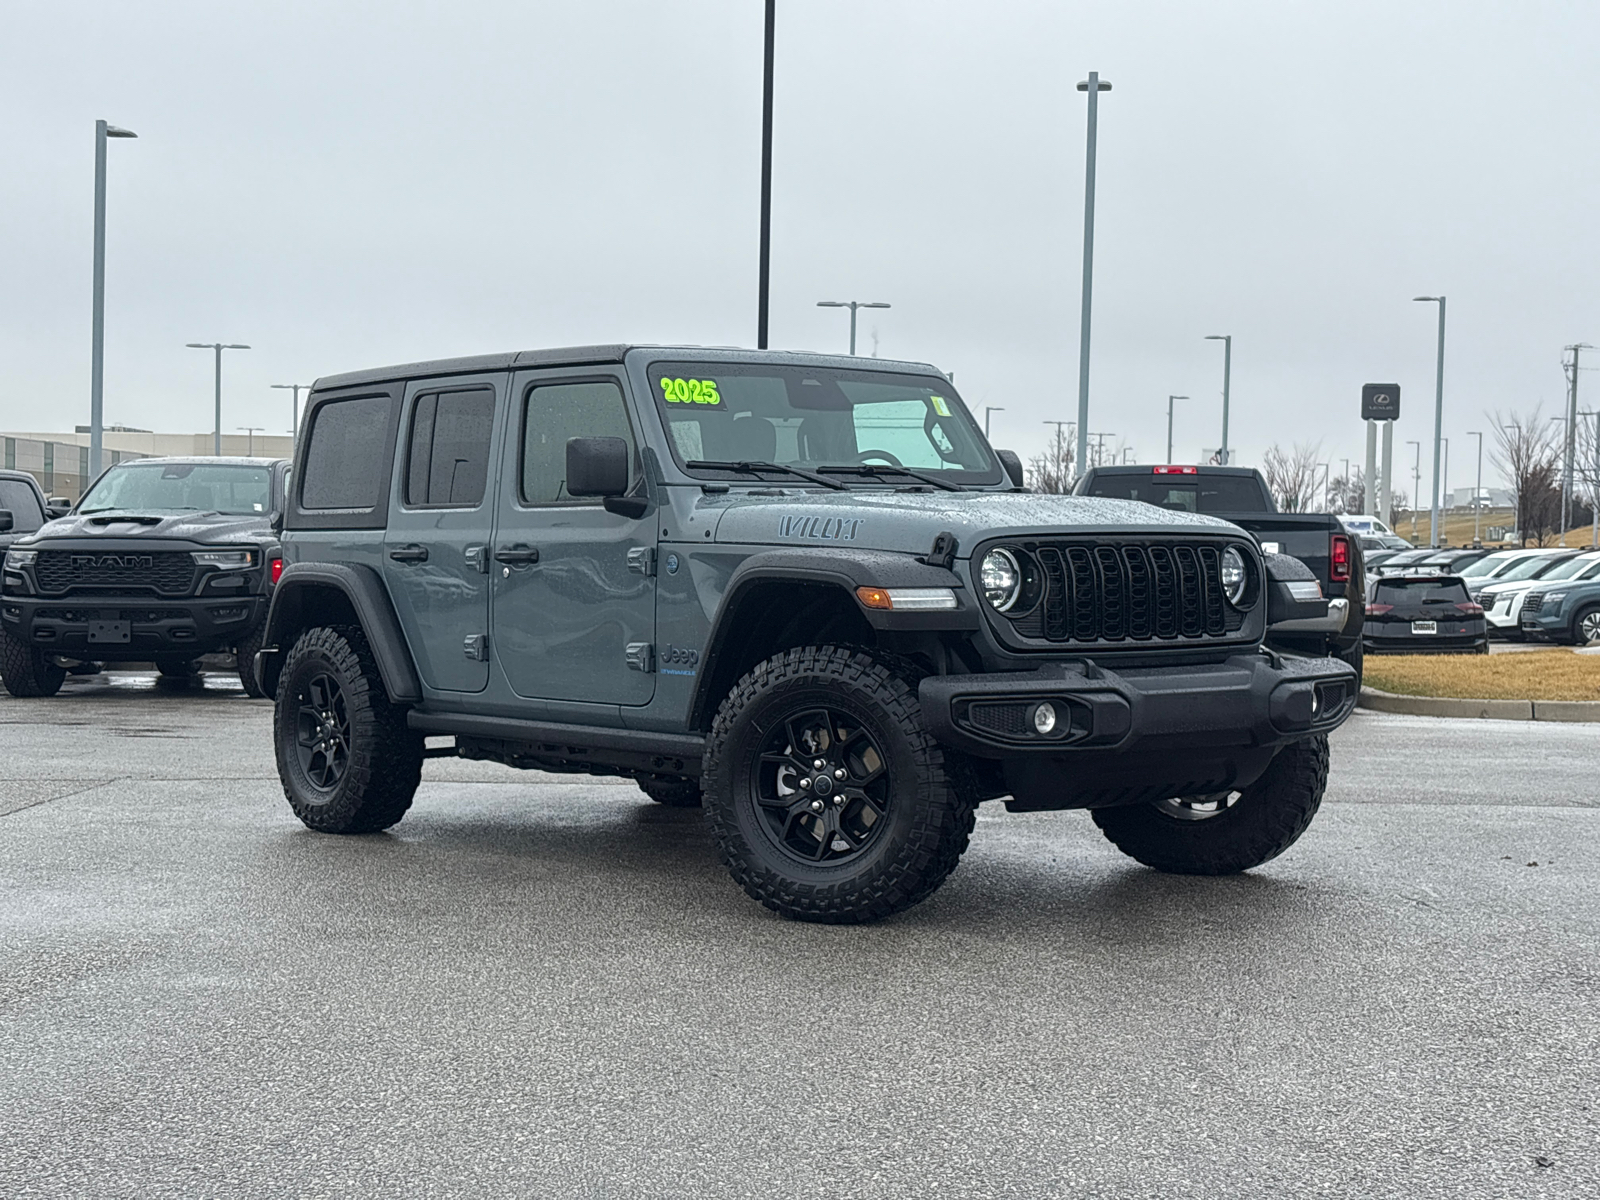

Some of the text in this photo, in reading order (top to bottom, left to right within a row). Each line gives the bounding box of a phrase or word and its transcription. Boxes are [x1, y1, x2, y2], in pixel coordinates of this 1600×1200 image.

[660, 377, 720, 405] 2025
[70, 555, 153, 567] RAM
[660, 643, 699, 668] Jeep
